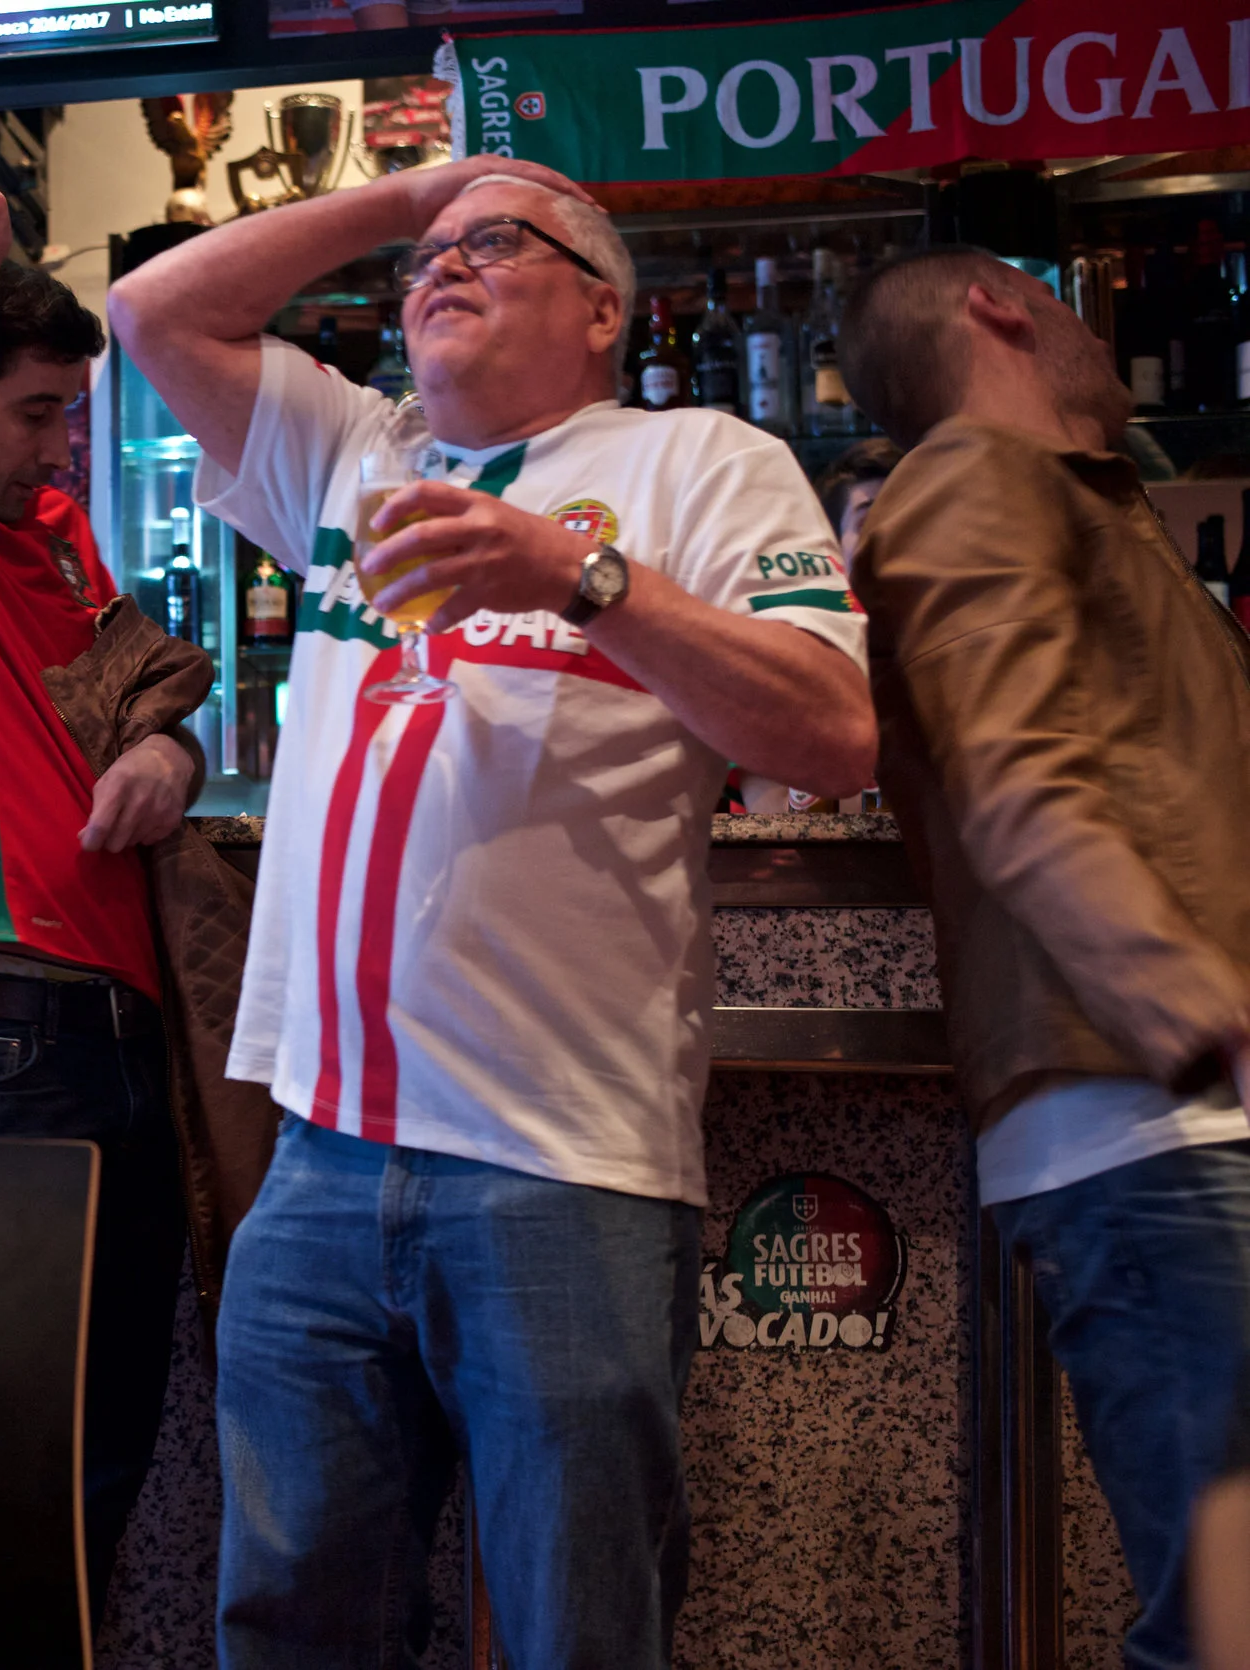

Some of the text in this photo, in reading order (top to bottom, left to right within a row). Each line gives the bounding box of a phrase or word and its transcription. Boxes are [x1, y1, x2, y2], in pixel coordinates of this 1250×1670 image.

[471, 56, 514, 159] SAGRES
[753, 1232, 862, 1263] SAGRES
[754, 1262, 867, 1287] FUTEBOL
[780, 1290, 836, 1304] GANHA!
